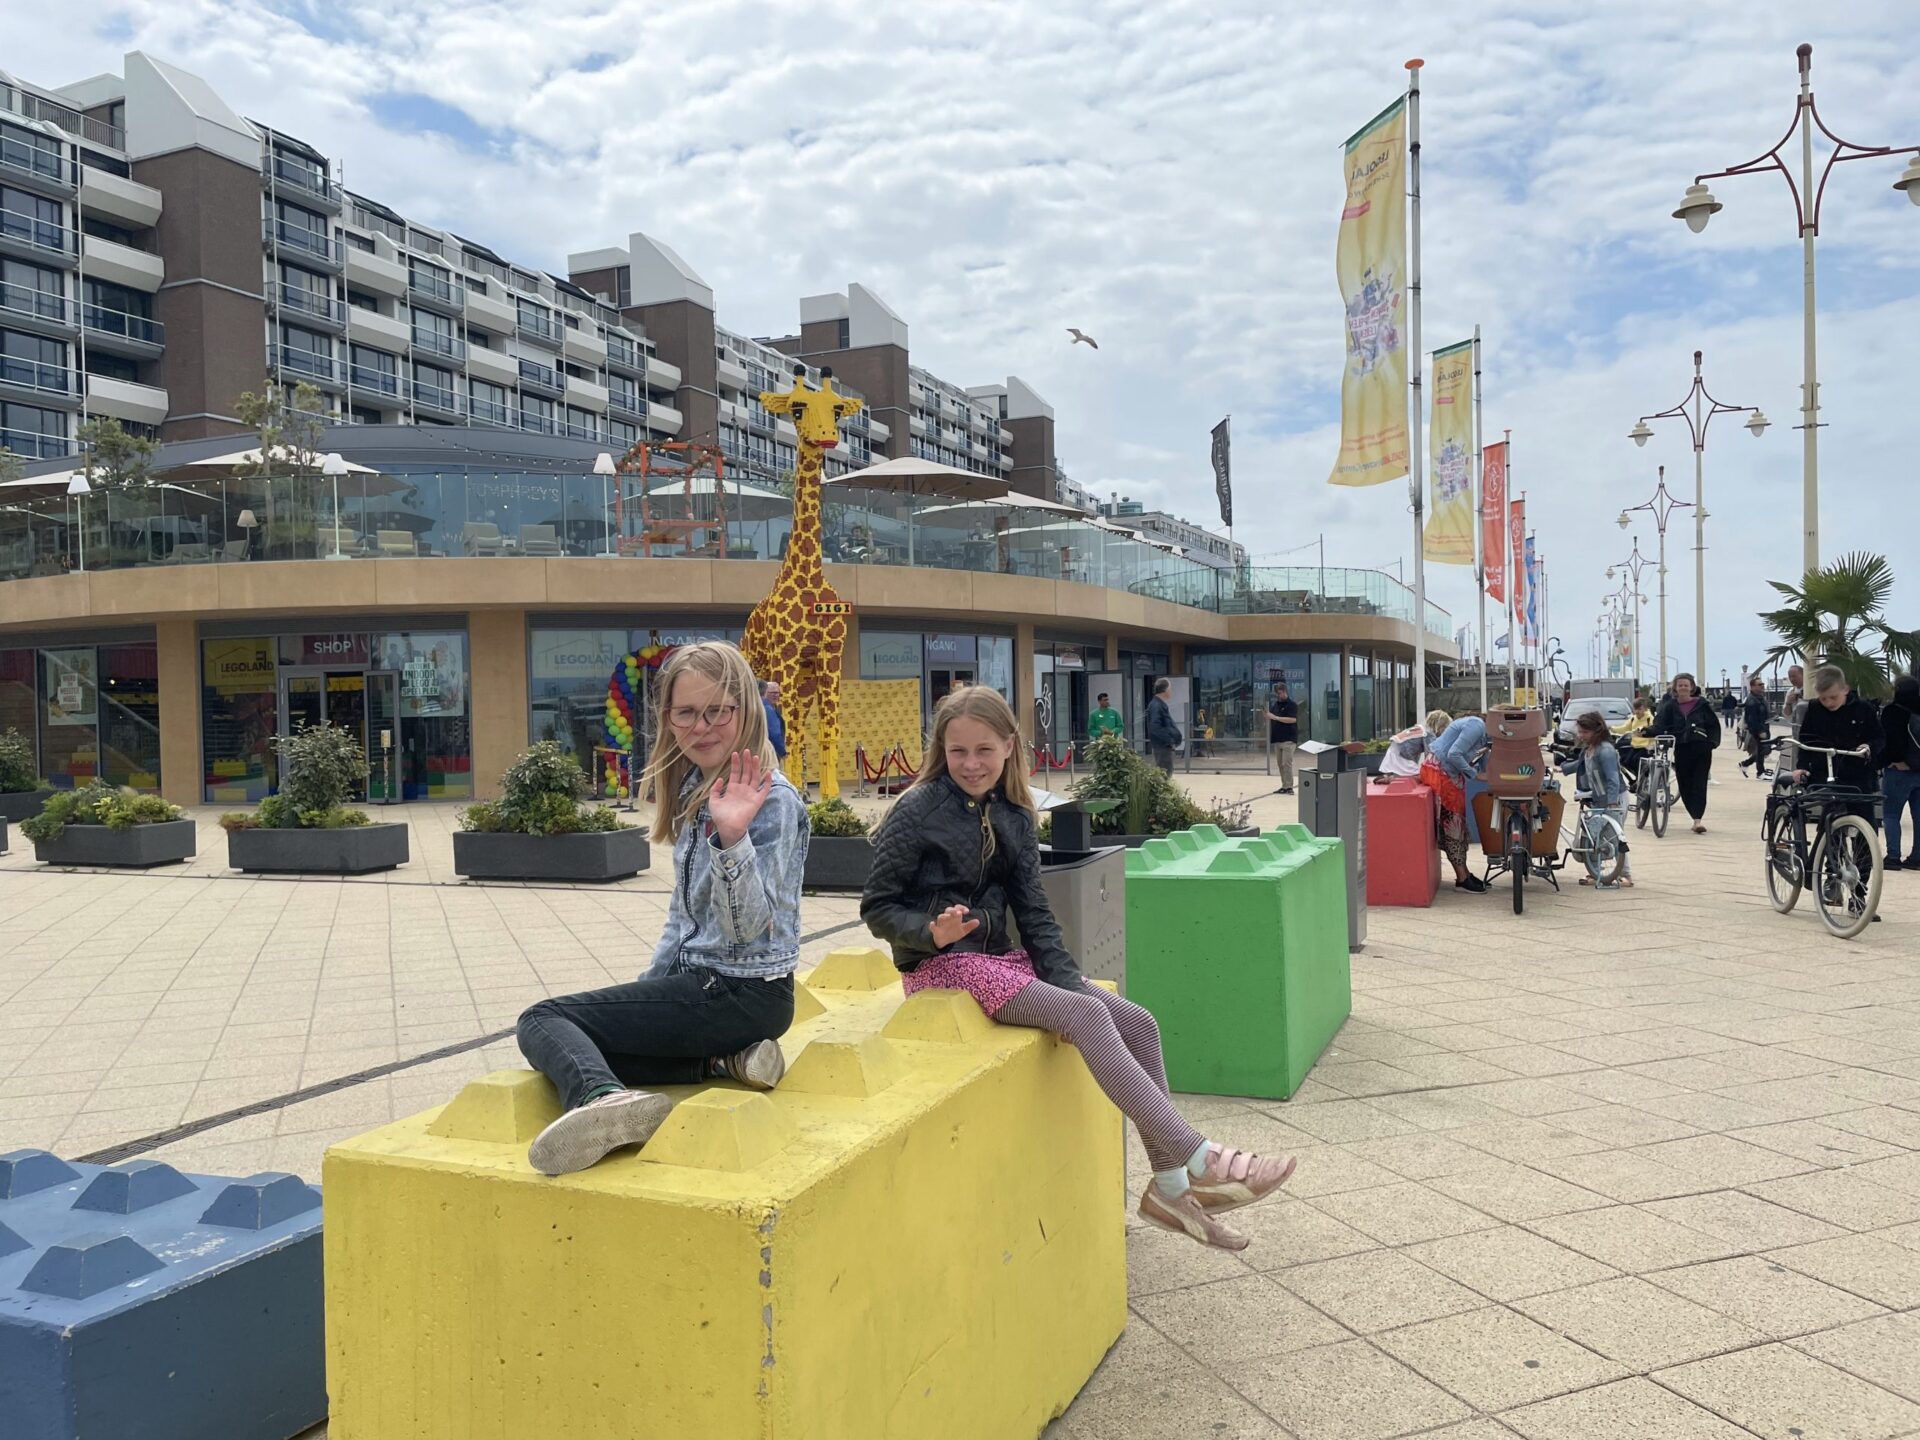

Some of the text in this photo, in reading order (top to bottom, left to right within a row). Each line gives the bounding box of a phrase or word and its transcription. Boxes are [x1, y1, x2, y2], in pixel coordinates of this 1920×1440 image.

[815, 604, 850, 613] GIGI
[313, 641, 352, 654] SHOP
[925, 640, 957, 651] NGANG
[554, 653, 622, 664] LEGOLAND
[874, 653, 919, 665] LEGOLAND
[220, 660, 275, 673] LEGOLAND
[405, 669, 436, 680] INDOOR
[411, 679, 430, 688] LEGO
[402, 687, 439, 696] SPEELPLEK
